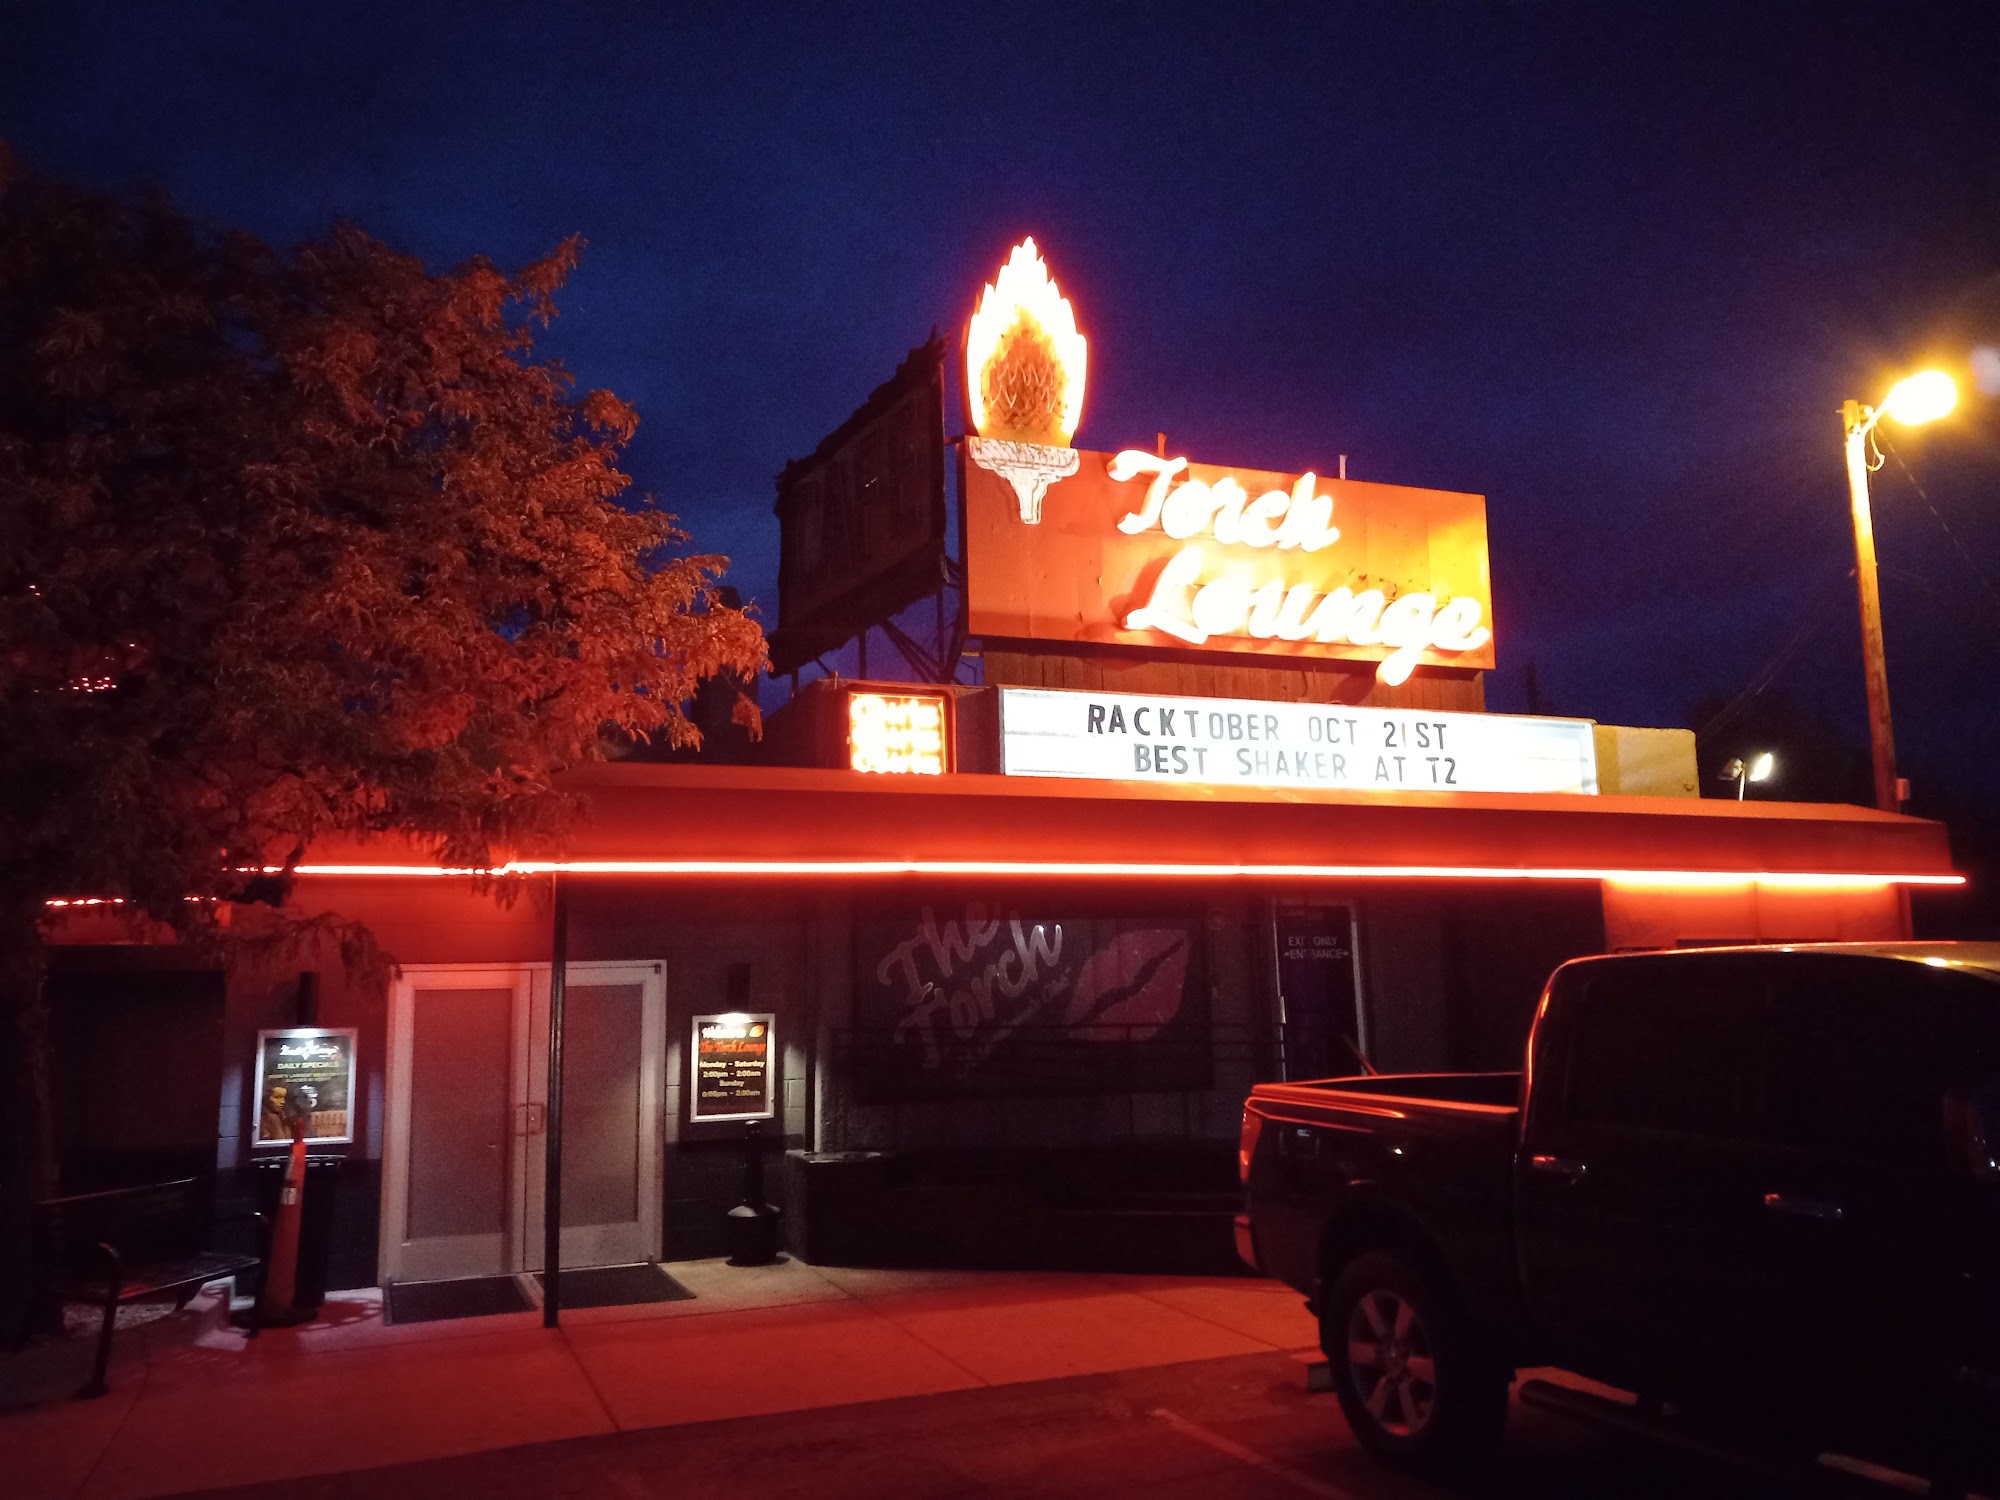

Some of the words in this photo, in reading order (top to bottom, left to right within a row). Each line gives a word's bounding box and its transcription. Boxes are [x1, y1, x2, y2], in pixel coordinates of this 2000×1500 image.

[1105, 449, 1341, 553] Torch
[1124, 546, 1492, 687] Lounge
[1087, 703, 1280, 742] RACKTOBER
[1308, 716, 1358, 745] OCT
[1383, 720, 1447, 750] 21ST
[1133, 743, 1209, 776] BEST
[1237, 747, 1348, 780] SHAKER
[1374, 755, 1407, 783] AT
[1425, 757, 1458, 785] T2
[1290, 949, 1342, 959] ENRANCE
[1313, 936, 1338, 946] ONLY
[277, 1062, 301, 1070] DAILY
[301, 1061, 340, 1069] SPECIALS
[699, 1061, 727, 1069] Monday
[734, 1060, 766, 1068] Saturday
